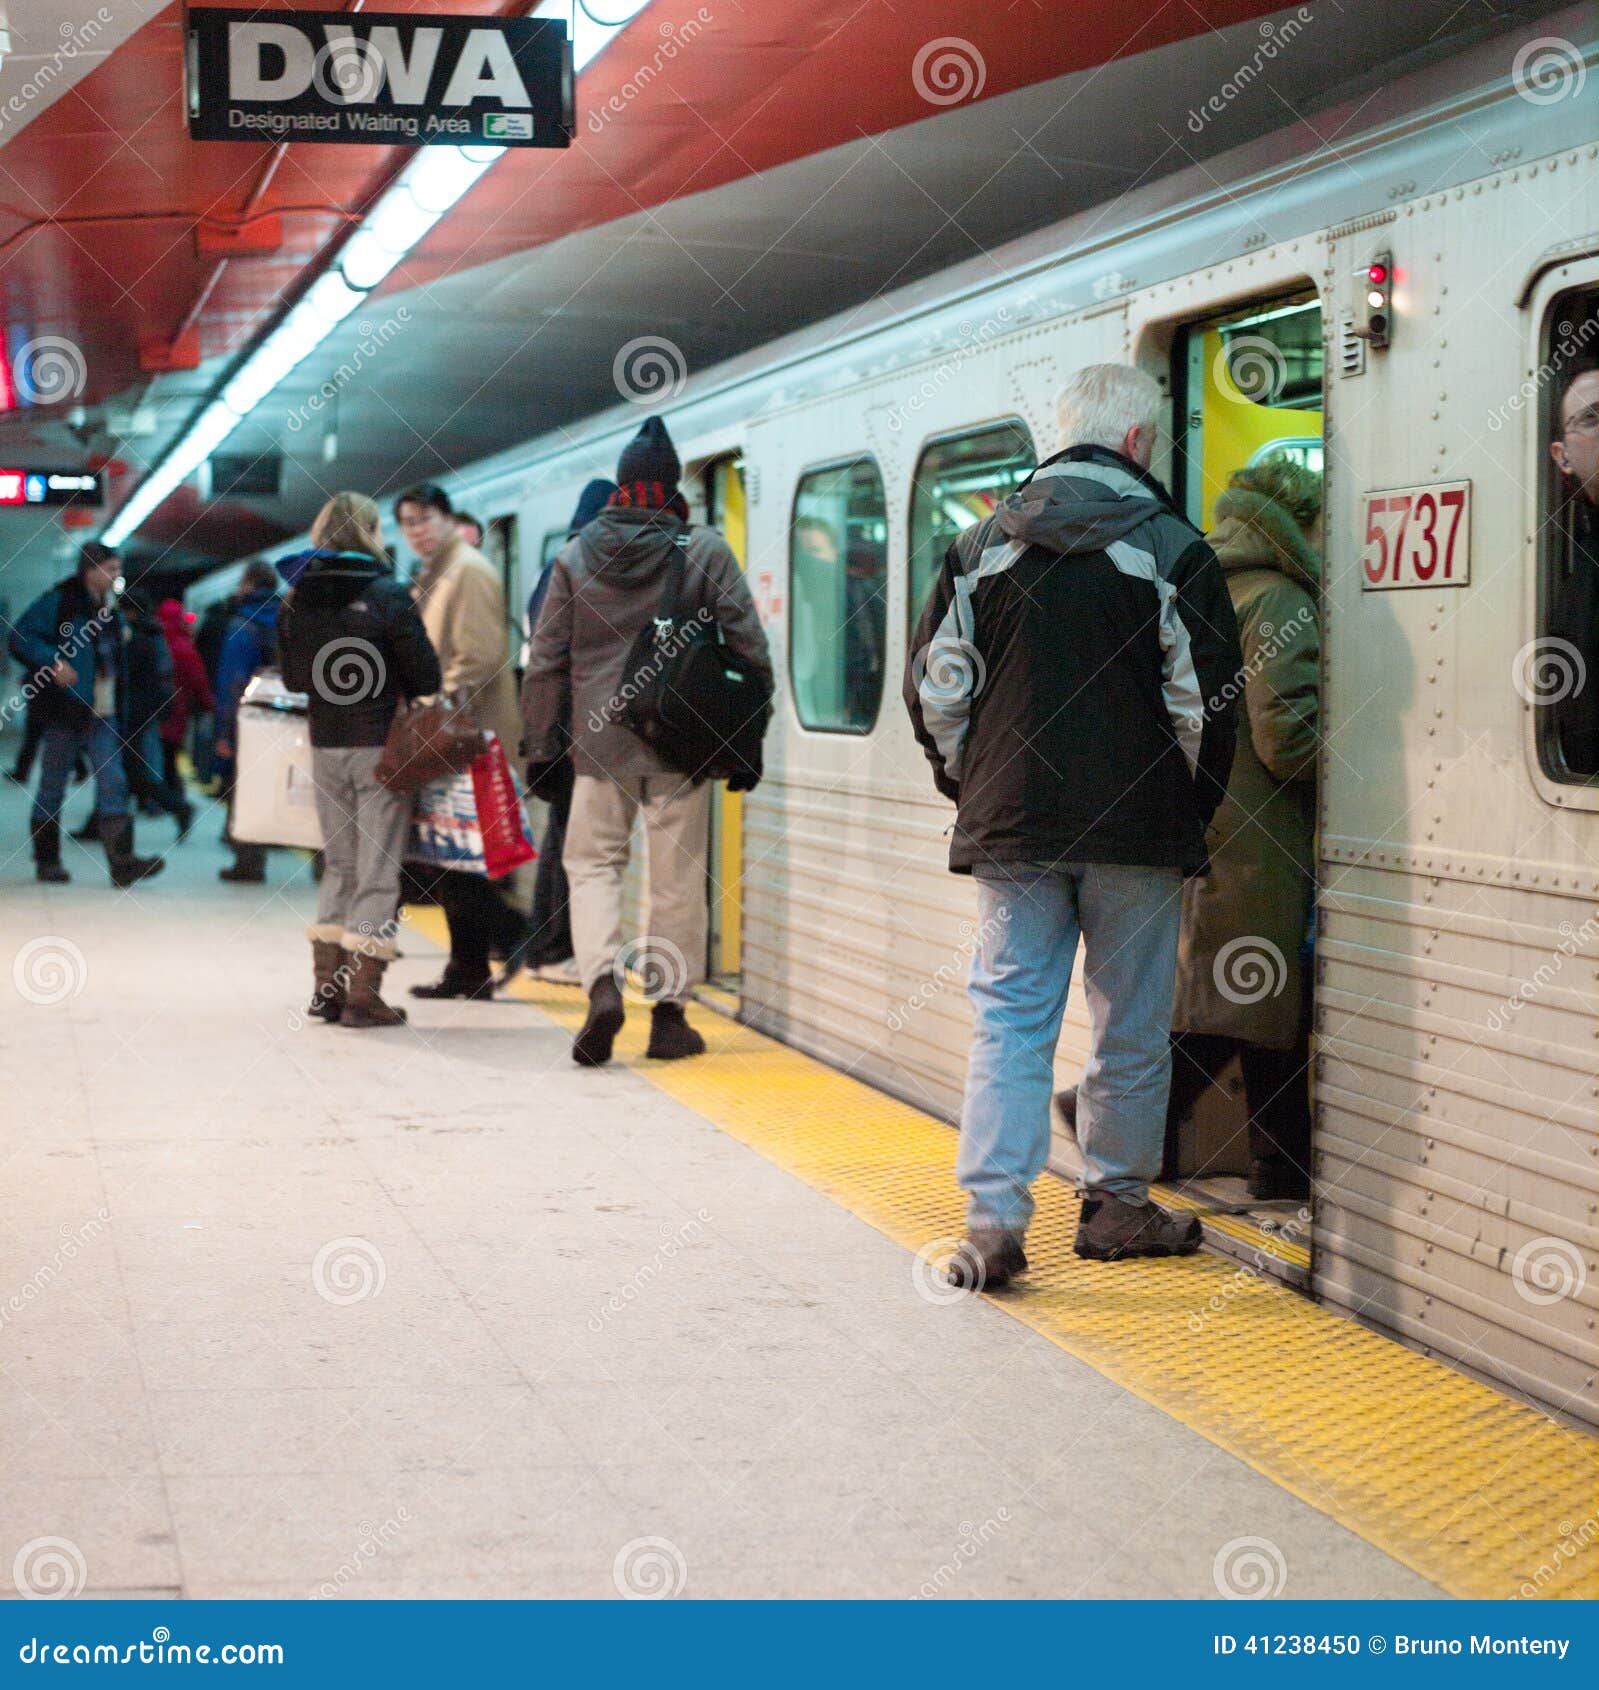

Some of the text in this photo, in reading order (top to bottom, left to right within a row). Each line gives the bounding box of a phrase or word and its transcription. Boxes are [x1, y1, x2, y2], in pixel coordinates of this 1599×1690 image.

[228, 22, 533, 108] DWA
[228, 109, 471, 136] Designated Waiting Area
[1364, 490, 1464, 583] 5737
